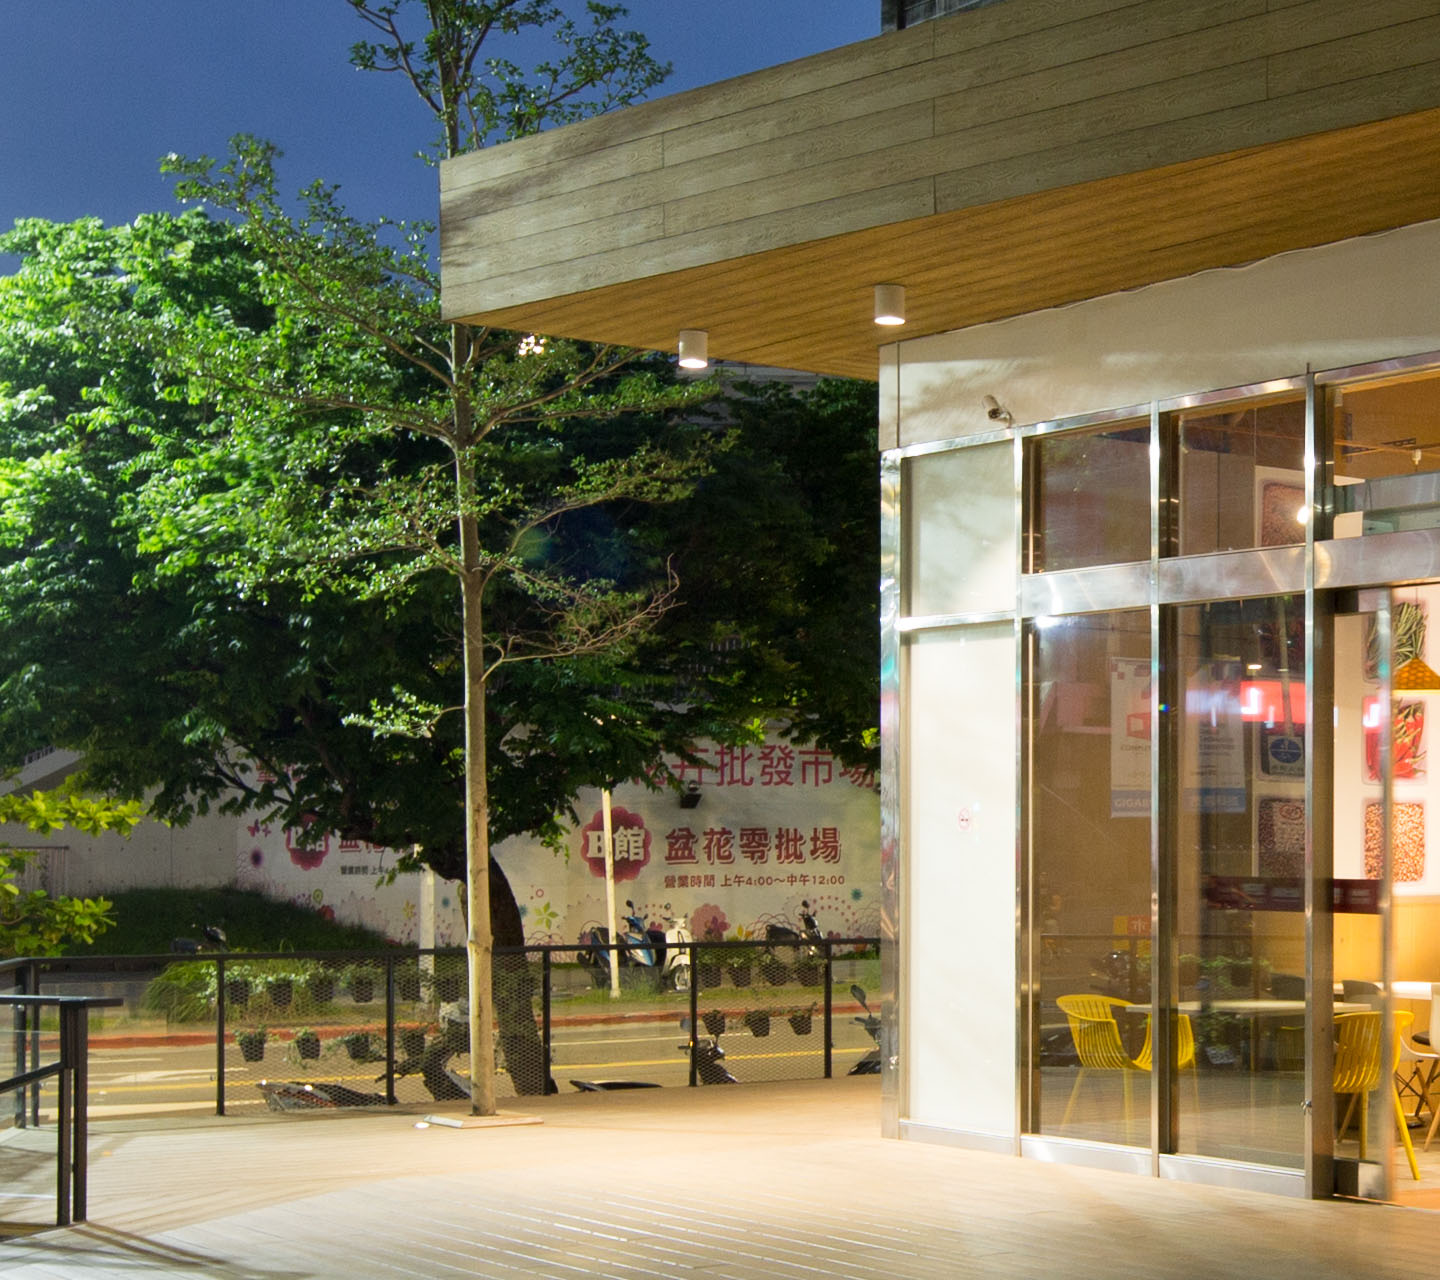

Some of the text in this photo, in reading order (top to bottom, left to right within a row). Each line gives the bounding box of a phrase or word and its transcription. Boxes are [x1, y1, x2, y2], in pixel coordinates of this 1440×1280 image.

[664, 827, 842, 865] 盆花零批場
[664, 875, 715, 888] 營業時間
